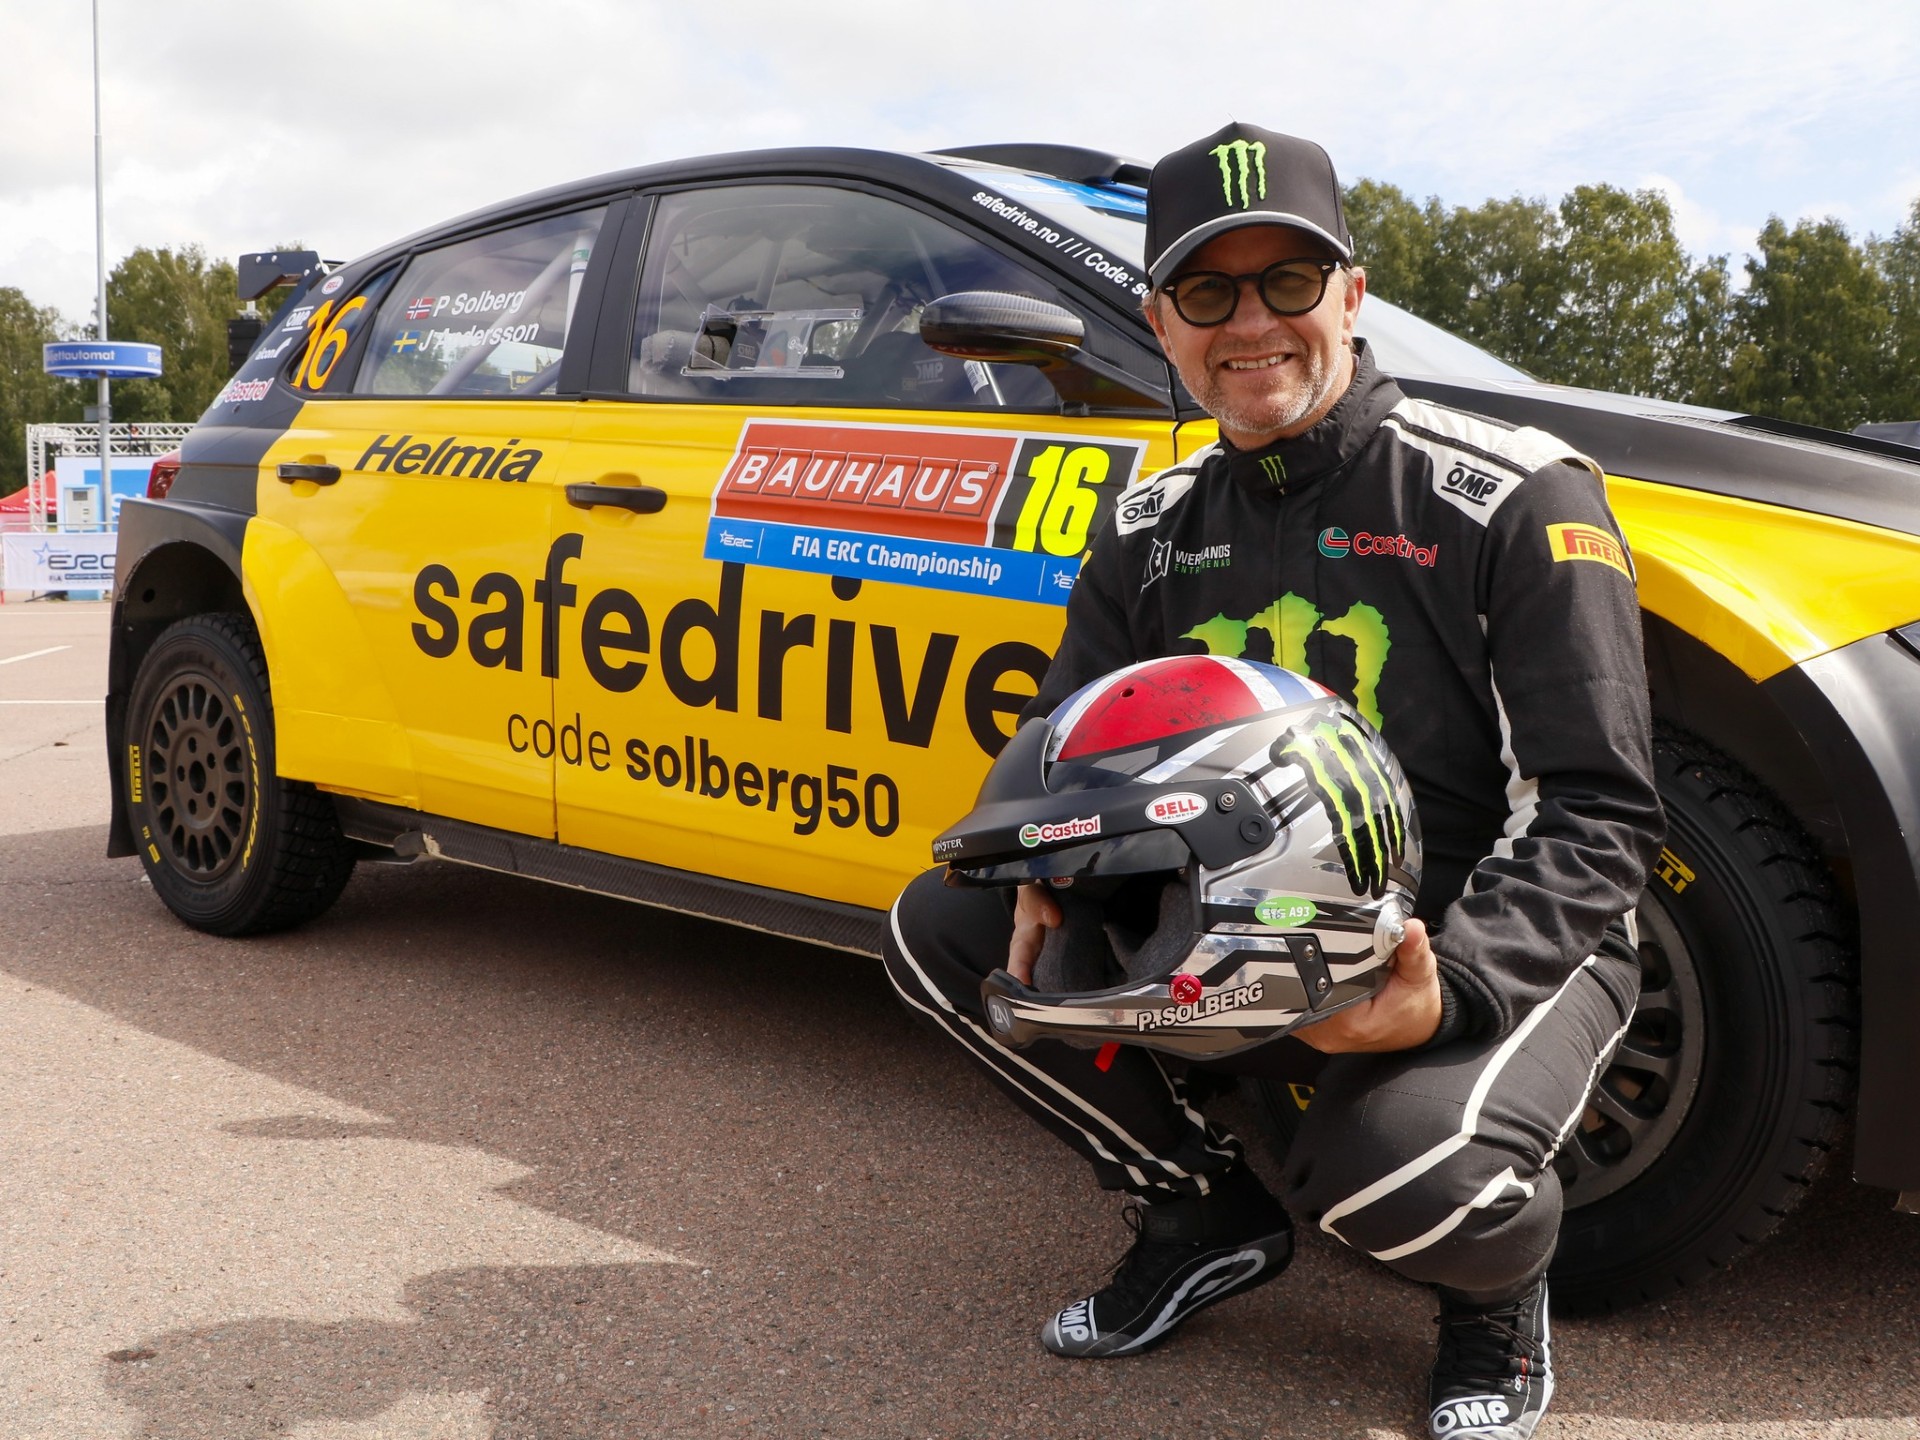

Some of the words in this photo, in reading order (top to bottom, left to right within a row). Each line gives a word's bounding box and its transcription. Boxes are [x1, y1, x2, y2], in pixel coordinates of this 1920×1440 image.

[972, 191, 1060, 244] safedrive.no
[1084, 252, 1135, 288] Code:
[285, 310, 312, 328] OMP
[432, 295, 452, 318] P
[451, 289, 527, 316] Solberg
[290, 295, 368, 390] 16
[418, 329, 435, 352] J
[434, 322, 540, 350] Andersson
[225, 377, 274, 402] Castrol
[355, 435, 543, 483] Helmia
[736, 454, 990, 506] BAUHAUS
[1446, 467, 1499, 499] OMP
[1013, 445, 1111, 558] 16
[1122, 492, 1165, 520] OMP
[722, 536, 754, 549] ERC
[791, 535, 820, 558] FIA
[826, 539, 861, 563] ERC
[866, 543, 1002, 582] Championship
[1352, 531, 1438, 567] Castrol
[48, 554, 116, 570] ERC
[411, 532, 1053, 761] safedrive
[507, 712, 612, 771] code
[625, 736, 900, 838] solberg50
[1154, 799, 1199, 817] BELL
[1041, 818, 1099, 841] Castrol
[1289, 906, 1310, 918] A93
[1182, 981, 1196, 995] LIFT
[1061, 1300, 1090, 1342] OMP
[1432, 1400, 1510, 1434] OMP
